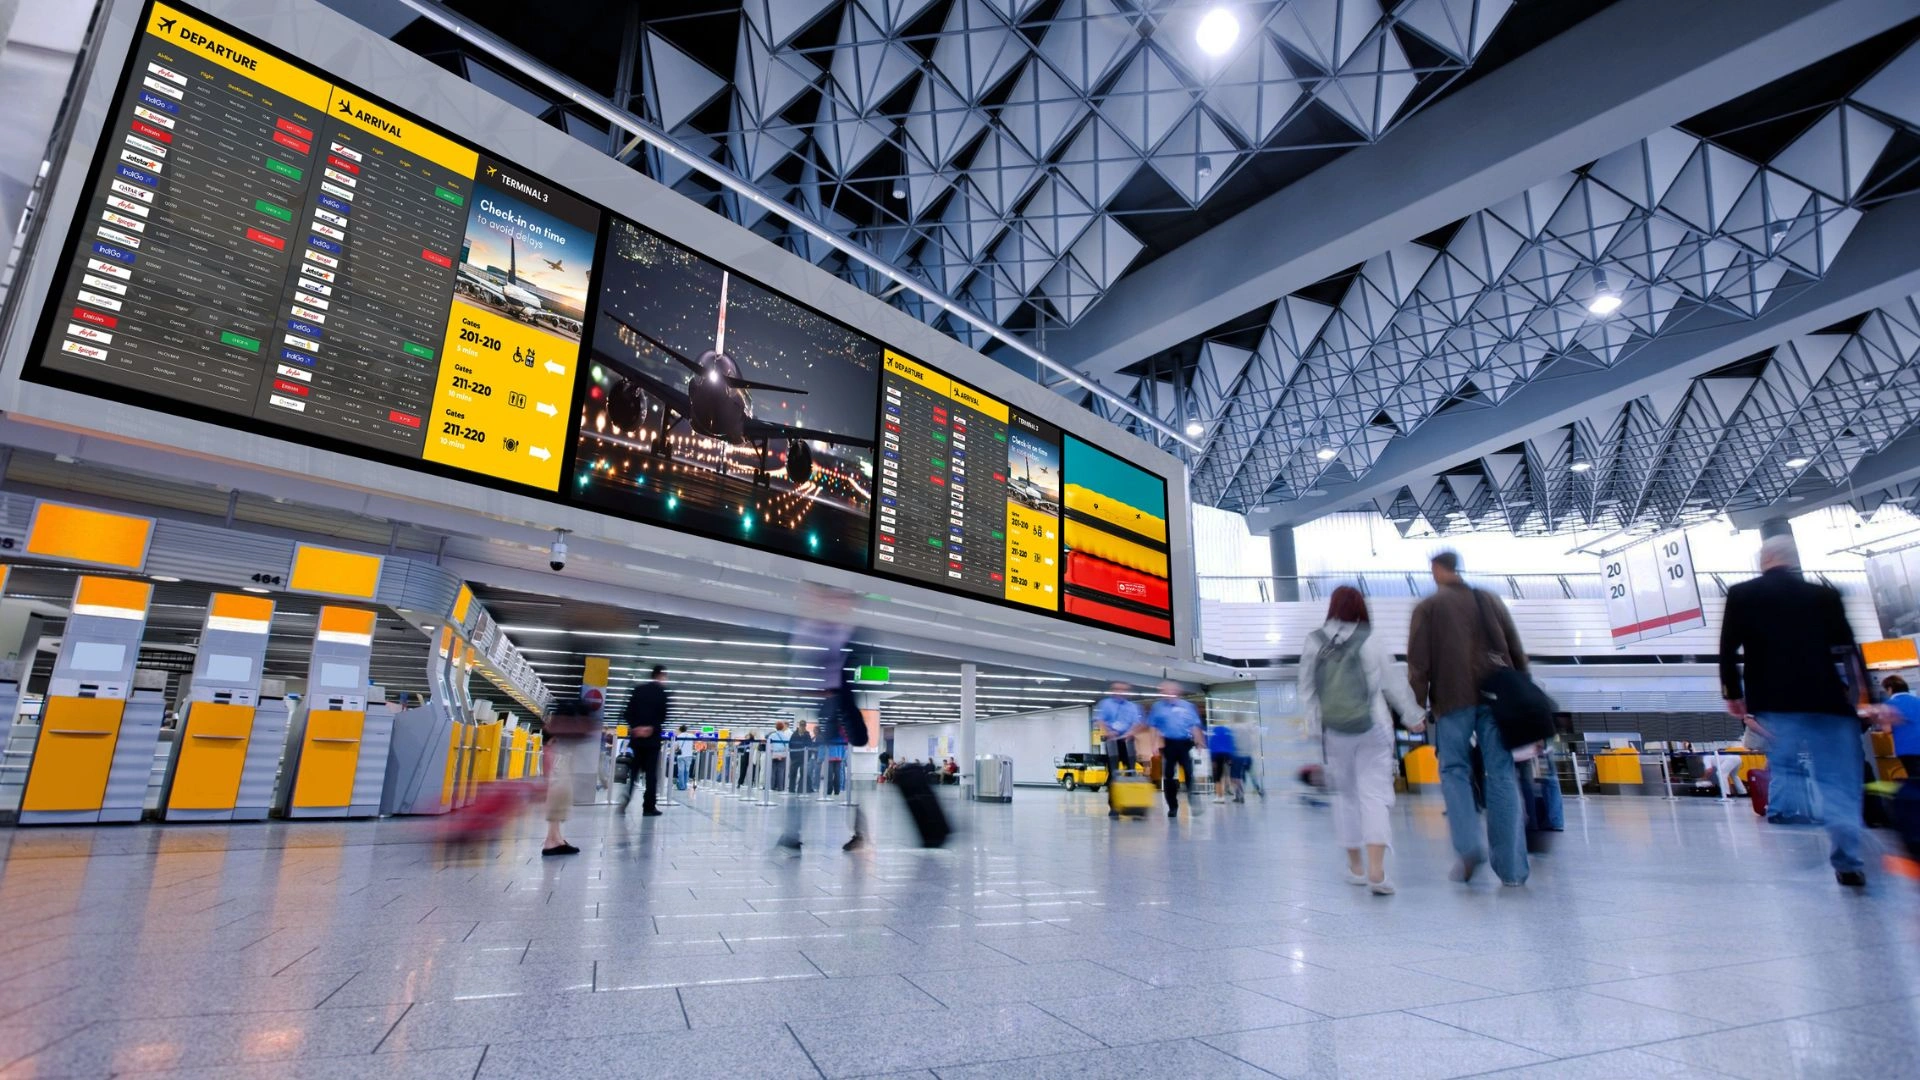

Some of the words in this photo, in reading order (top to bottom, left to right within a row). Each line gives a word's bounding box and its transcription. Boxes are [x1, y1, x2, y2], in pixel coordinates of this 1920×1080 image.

[180, 28, 258, 71] DEPARTURE
[144, 95, 165, 108] IndiGo
[355, 110, 402, 138] ARRIVAL
[126, 154, 148, 166] Jetstar
[122, 168, 144, 181] IndiGo
[118, 184, 137, 193] QATAR
[501, 174, 541, 200] TERMINAL
[542, 194, 549, 202] 3
[480, 199, 527, 228] Check-in
[529, 224, 541, 235] on
[544, 228, 566, 245] time
[477, 214, 487, 225] to
[489, 219, 514, 236] avoid
[516, 230, 543, 249] delays
[98, 246, 121, 259] IndiGo
[462, 317, 481, 329] Gates
[459, 328, 501, 351] 201-210
[457, 344, 461, 352] 5
[462, 346, 478, 357] mins
[454, 363, 473, 375] Gates
[894, 361, 924, 380] DEPARTURE
[452, 376, 492, 397] 211-220
[456, 391, 472, 402] mins
[445, 408, 465, 420] Gates
[443, 421, 486, 443] 211-220
[448, 439, 465, 450] mins
[0, 537, 15, 549] 5
[1662, 541, 1679, 558] 10
[1606, 562, 1621, 578] 20
[1667, 564, 1684, 580] 10
[251, 573, 280, 585] 464
[1610, 584, 1625, 600] 20
